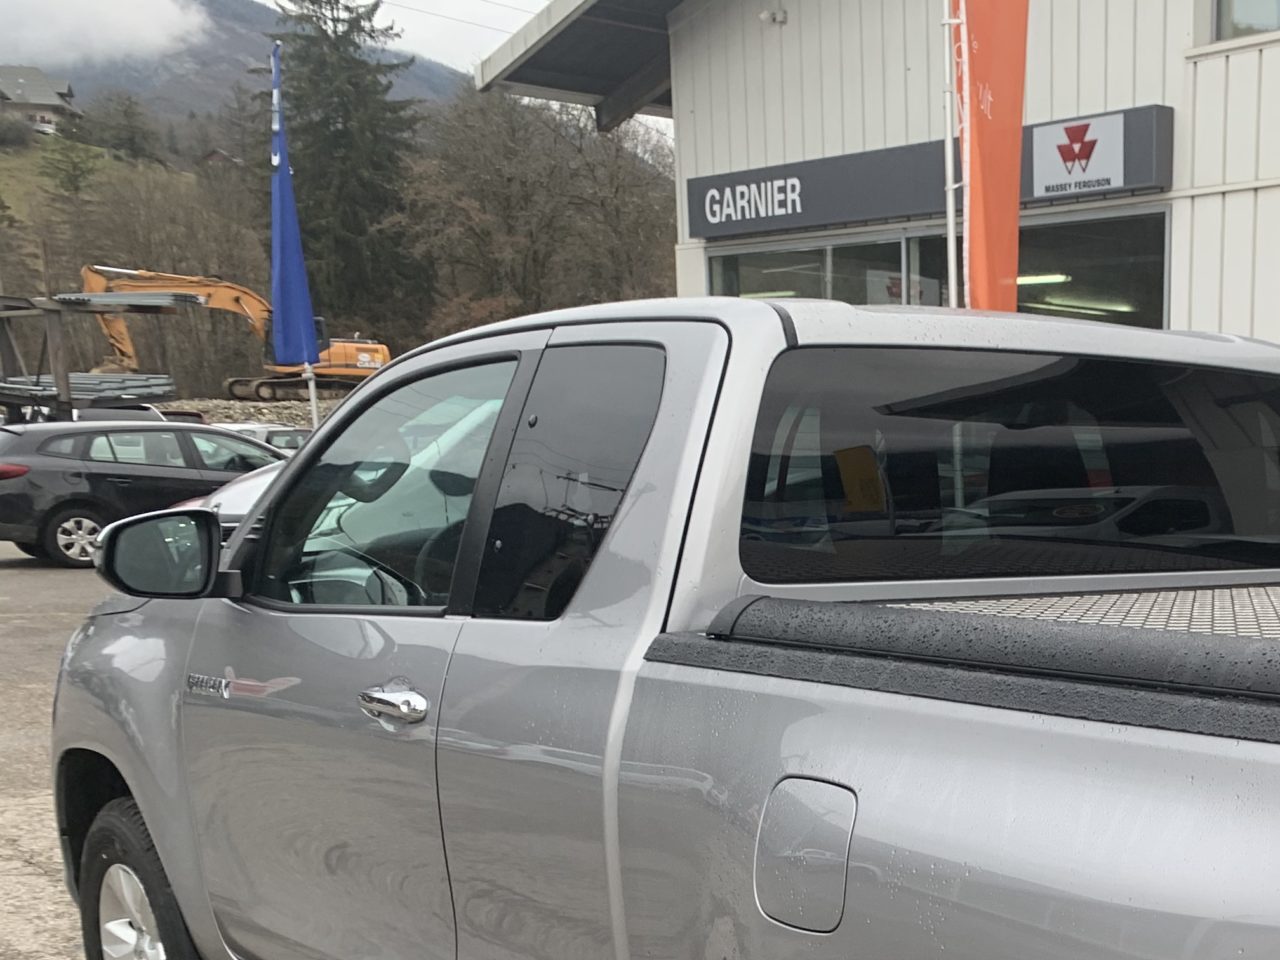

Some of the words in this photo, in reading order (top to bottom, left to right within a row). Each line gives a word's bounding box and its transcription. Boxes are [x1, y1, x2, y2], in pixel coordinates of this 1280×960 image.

[705, 177, 802, 223] GARNIER
[1045, 182, 1072, 193] MASSEY
[1074, 177, 1111, 190] FERGUSON
